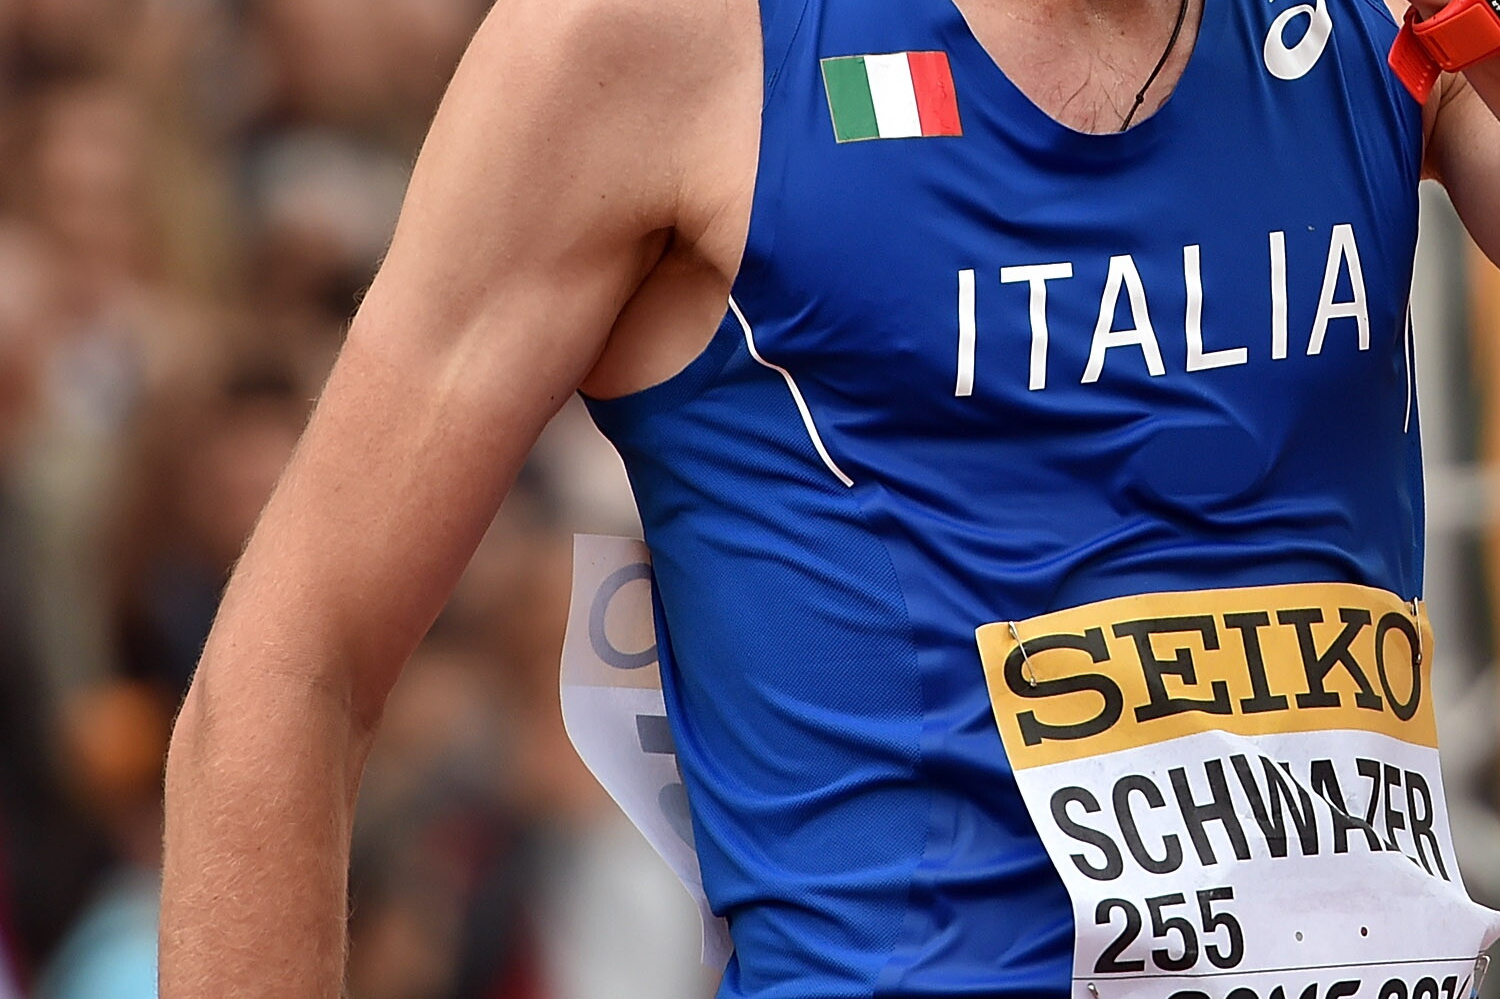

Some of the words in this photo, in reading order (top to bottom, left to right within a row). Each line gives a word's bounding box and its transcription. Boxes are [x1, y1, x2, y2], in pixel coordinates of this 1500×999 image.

[955, 223, 1370, 396] ITALIA
[1003, 607, 1421, 746] SEIKO
[1049, 754, 1451, 882] SCHWAZER
[1093, 886, 1246, 973] 255
